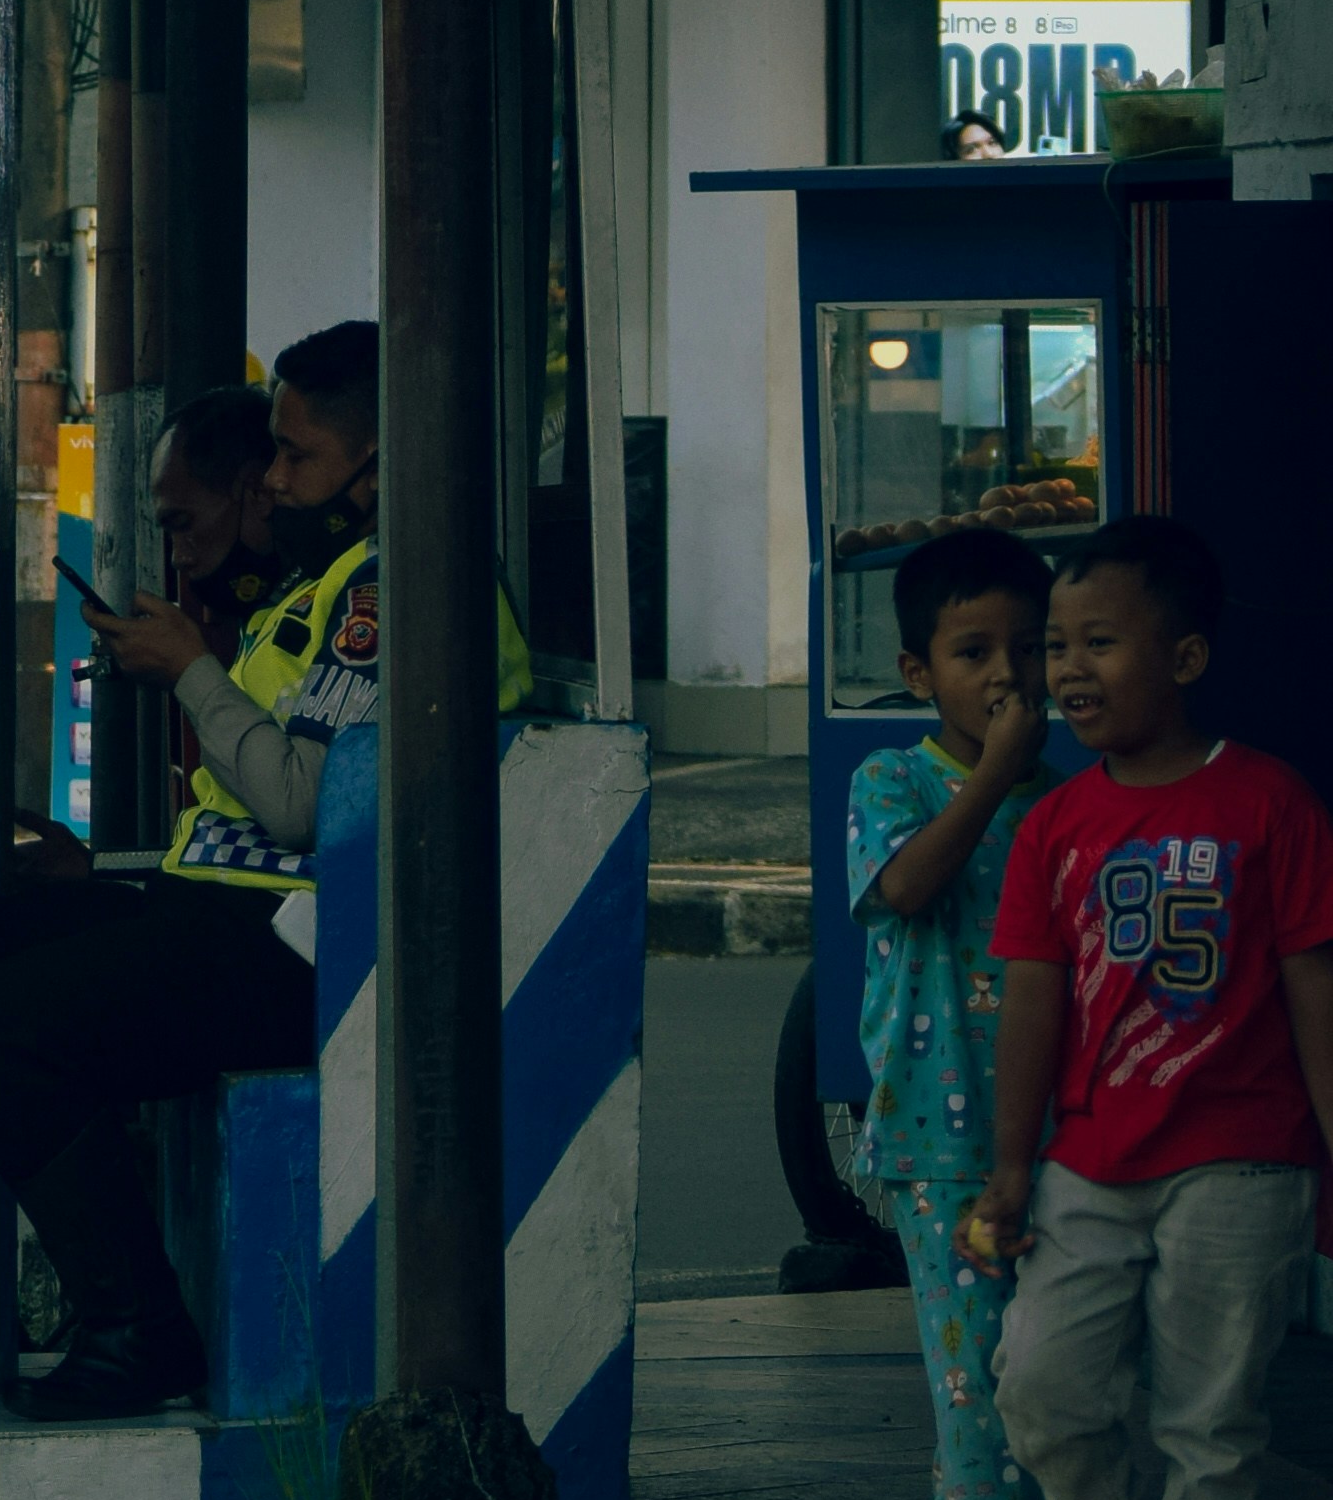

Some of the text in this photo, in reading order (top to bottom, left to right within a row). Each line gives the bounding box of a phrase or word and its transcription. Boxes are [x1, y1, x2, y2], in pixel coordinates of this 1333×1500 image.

[941, 14, 996, 34] alme
[1005, 17, 1017, 35] 8
[1036, 17, 1048, 35] 8
[70, 435, 94, 449] viv
[1163, 840, 1218, 882] 19
[1099, 858, 1224, 992] 85
